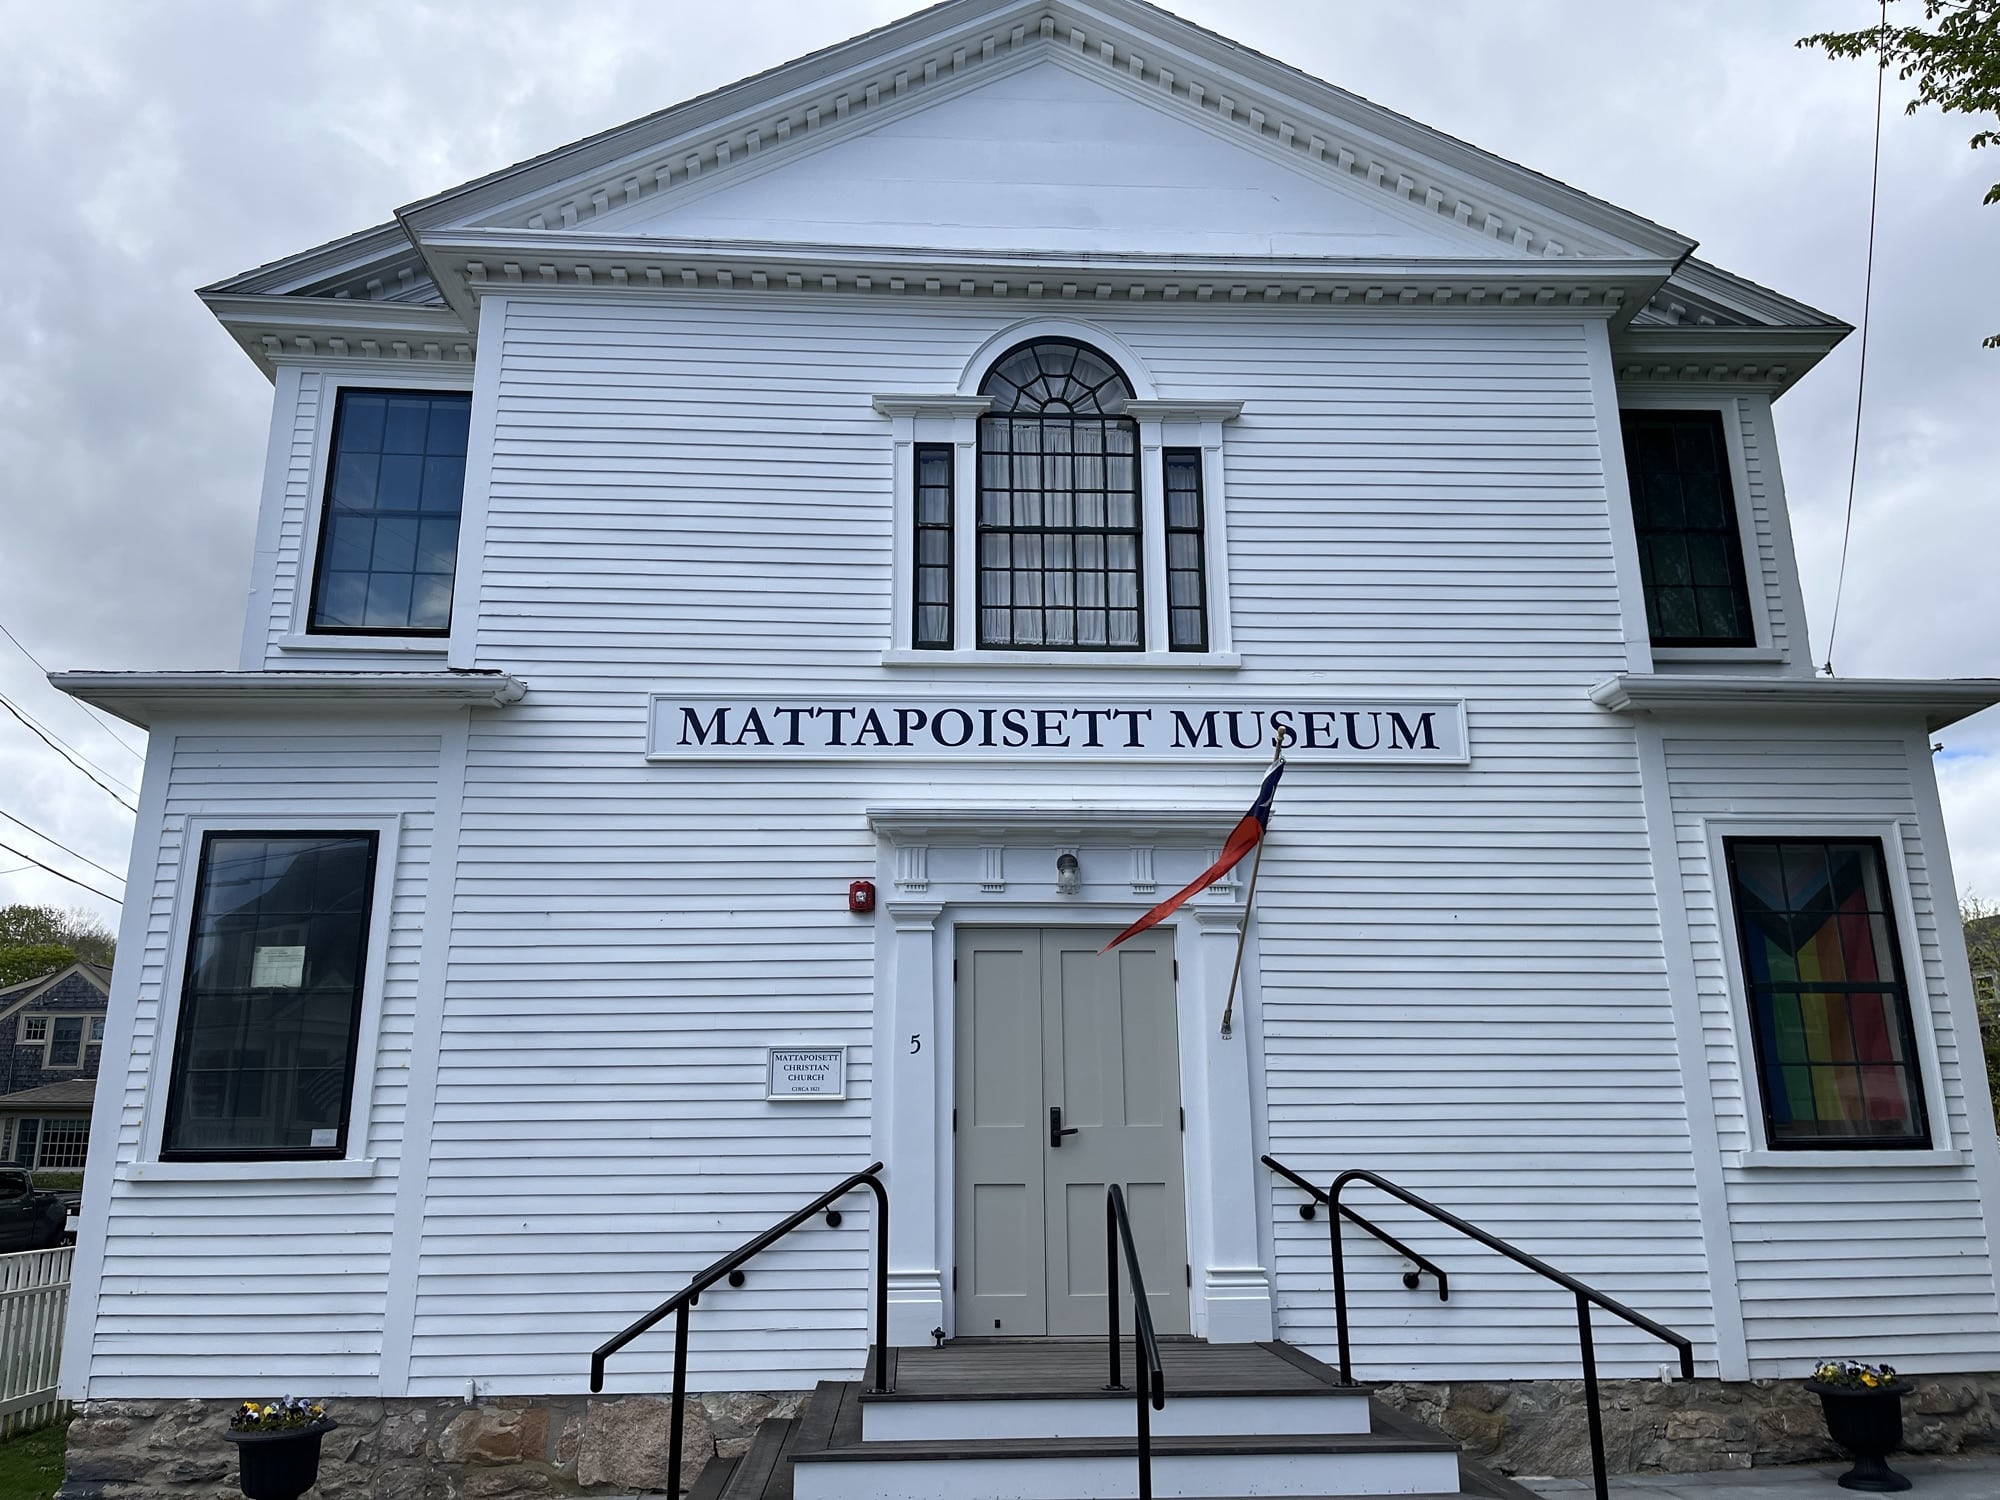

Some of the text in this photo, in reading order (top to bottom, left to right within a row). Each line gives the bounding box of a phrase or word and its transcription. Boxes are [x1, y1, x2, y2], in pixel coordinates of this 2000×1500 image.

[676, 706, 1441, 750] MATTAPOISETT MUSEUM
[910, 1033, 921, 1055] 5
[775, 1054, 839, 1062] MATTAPOISETT
[783, 1064, 830, 1072] CHRISTIAN
